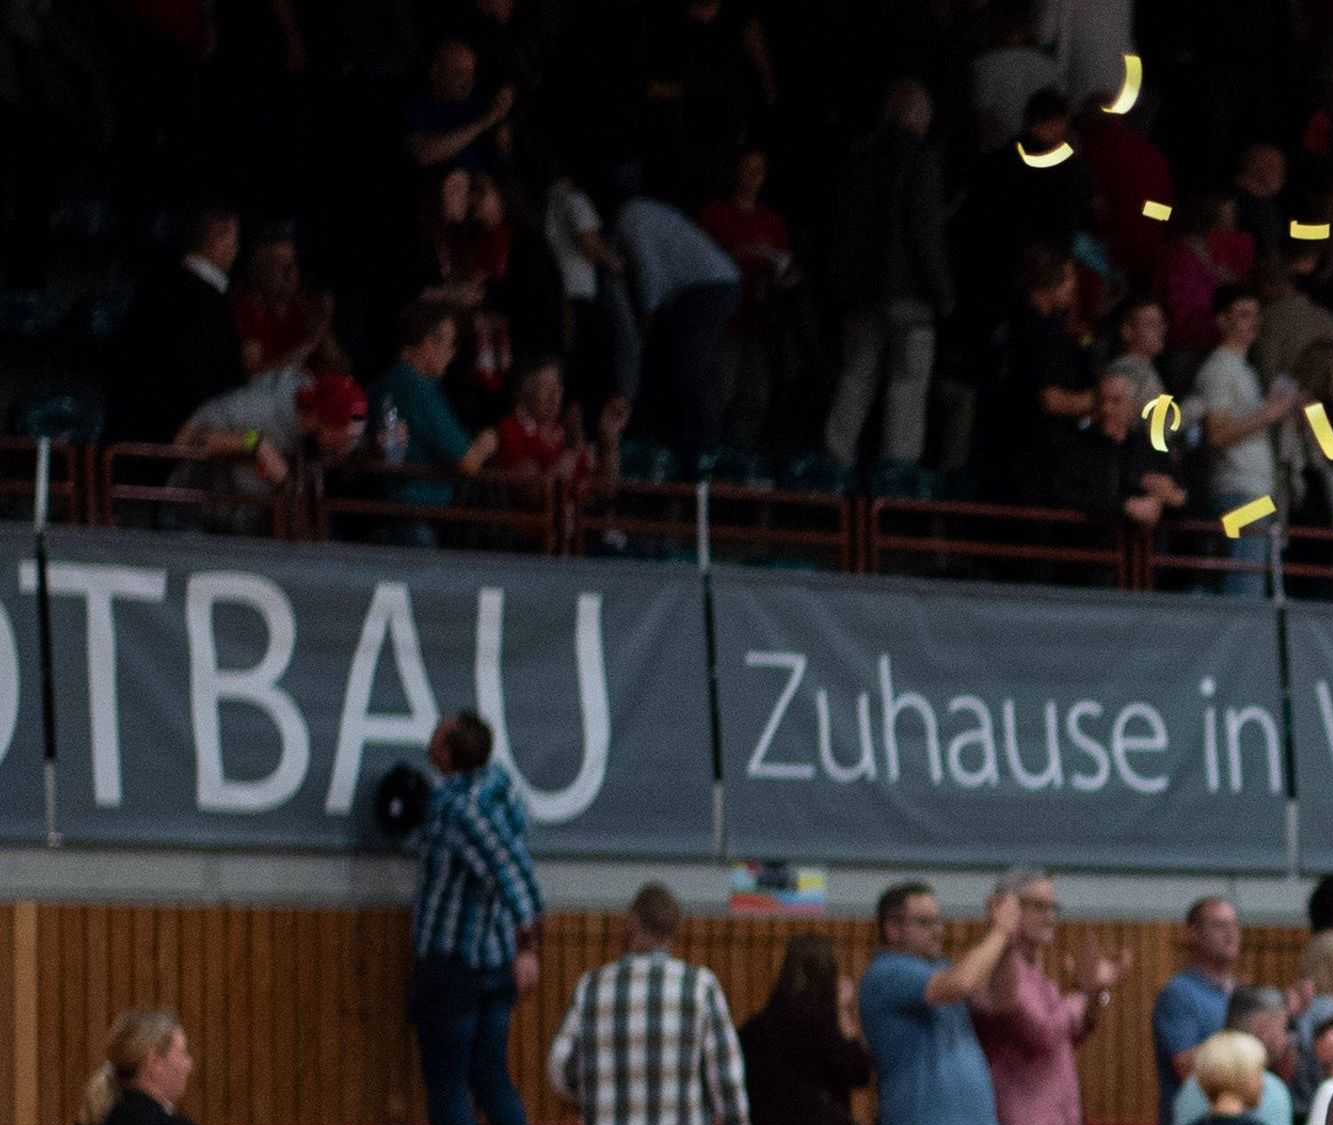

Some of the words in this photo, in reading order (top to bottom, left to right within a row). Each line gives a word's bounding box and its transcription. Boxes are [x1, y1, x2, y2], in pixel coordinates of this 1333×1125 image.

[0, 560, 611, 823] TBAU
[745, 652, 1171, 793] Zuhause
[1200, 677, 1283, 794] in
